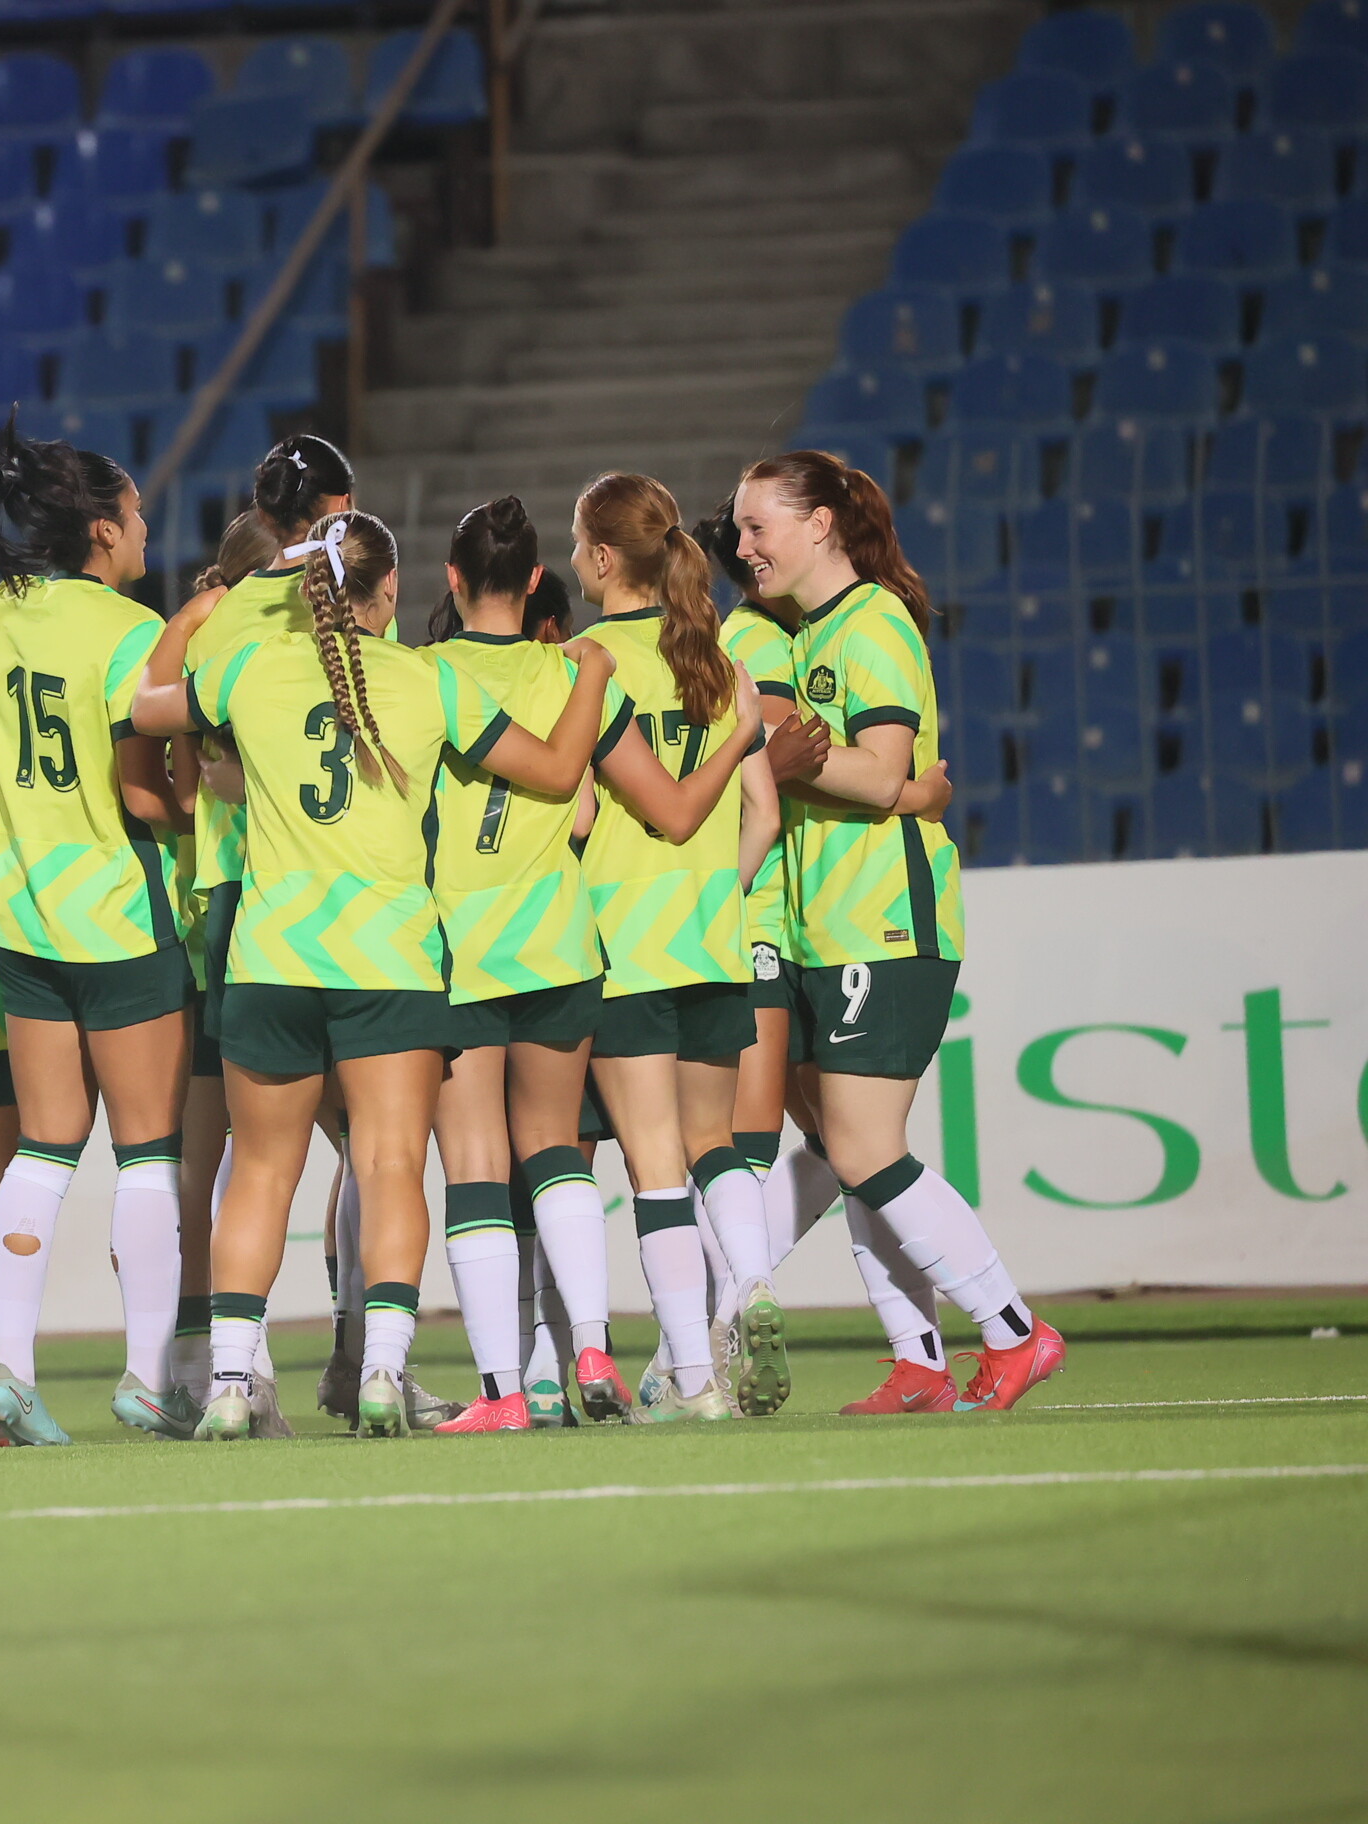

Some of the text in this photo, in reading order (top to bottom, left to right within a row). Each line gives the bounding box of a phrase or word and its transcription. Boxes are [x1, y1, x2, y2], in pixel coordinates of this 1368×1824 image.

[7, 665, 81, 793] 15
[299, 700, 356, 826] 3
[841, 962, 871, 1024] 9
